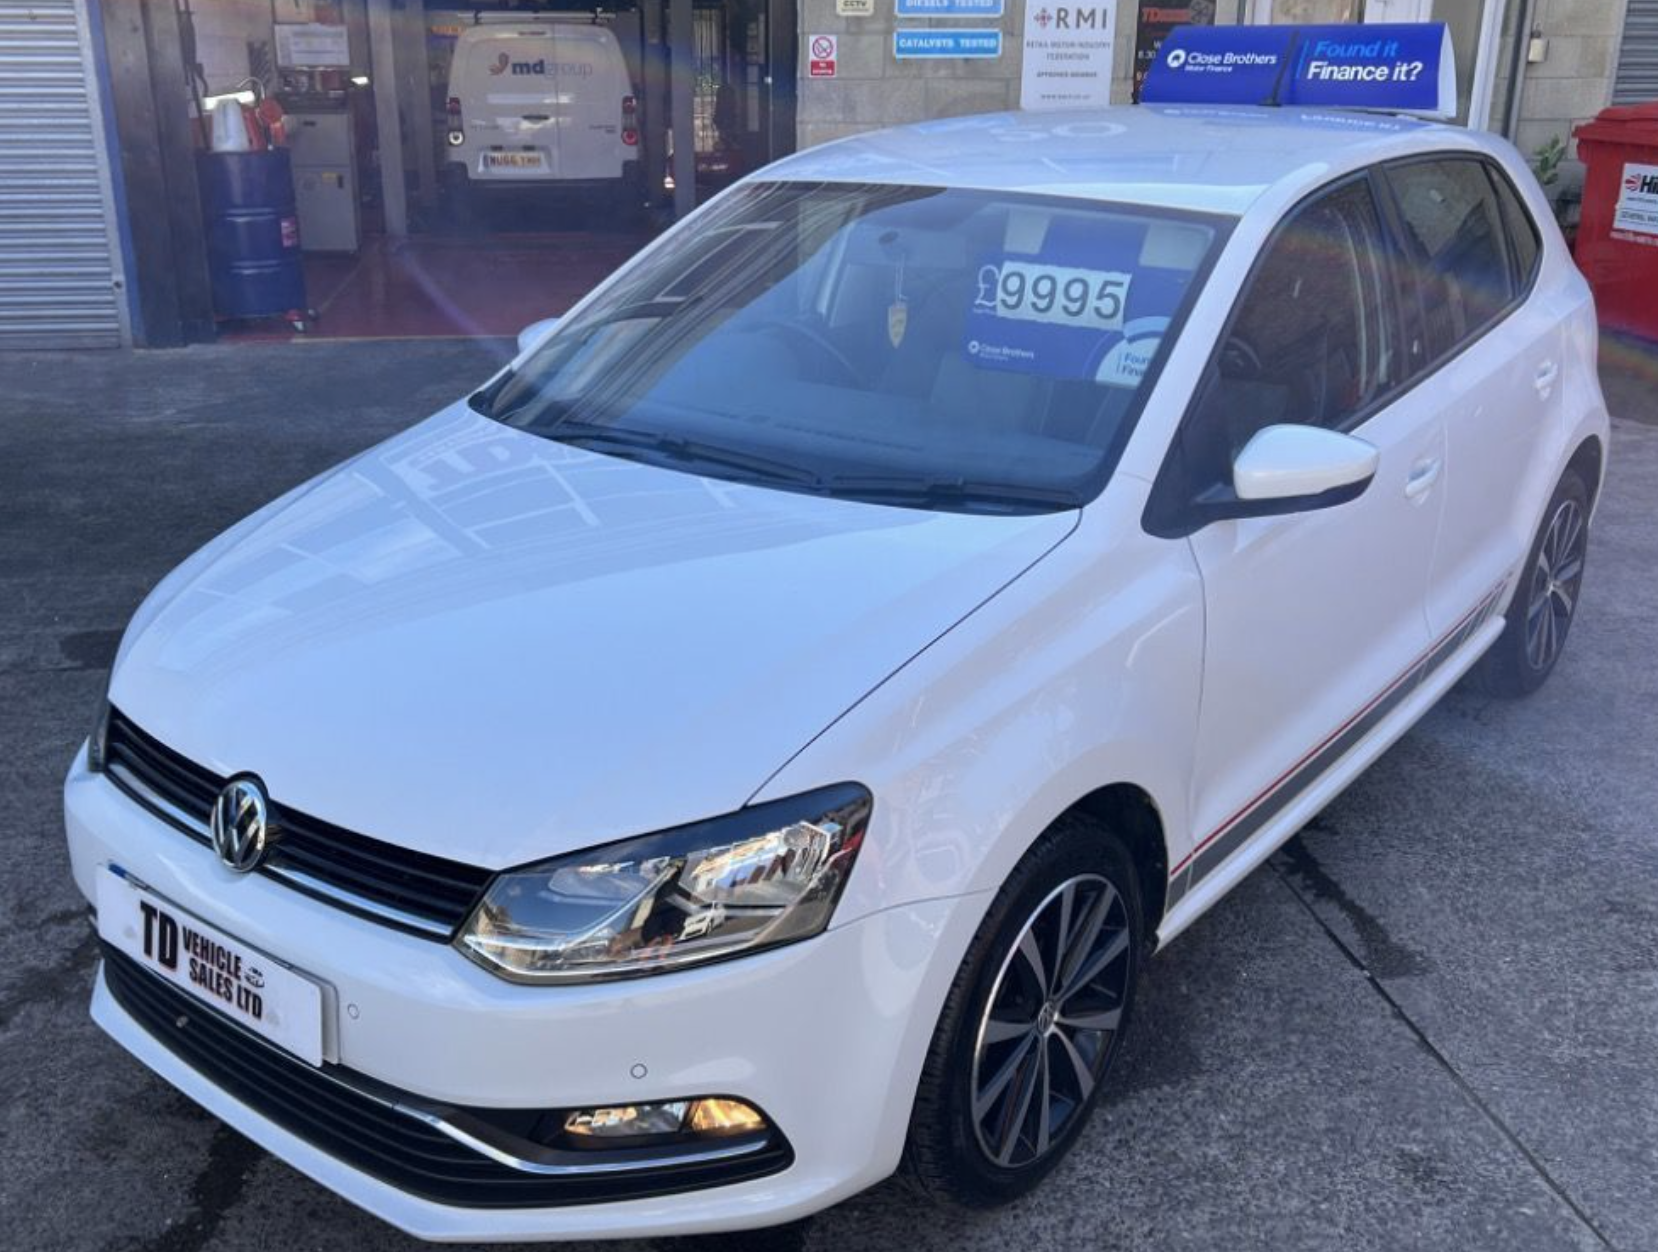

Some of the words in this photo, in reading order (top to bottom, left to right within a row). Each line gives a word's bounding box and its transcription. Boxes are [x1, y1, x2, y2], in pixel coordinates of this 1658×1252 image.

[1055, 7, 1108, 30] RMI
[900, 38, 954, 48] CATALYSTS
[959, 38, 997, 48] TESTED
[1314, 40, 1382, 58] Found
[1383, 40, 1399, 58] it
[1187, 52, 1223, 65] Close
[1223, 52, 1278, 65] Brothers
[1306, 61, 1389, 81] Finance
[1392, 60, 1424, 81] it?
[139, 898, 179, 972] TD
[182, 925, 242, 980] VEHICLE
[189, 957, 233, 1004] SALES
[236, 983, 263, 1021] LTD
